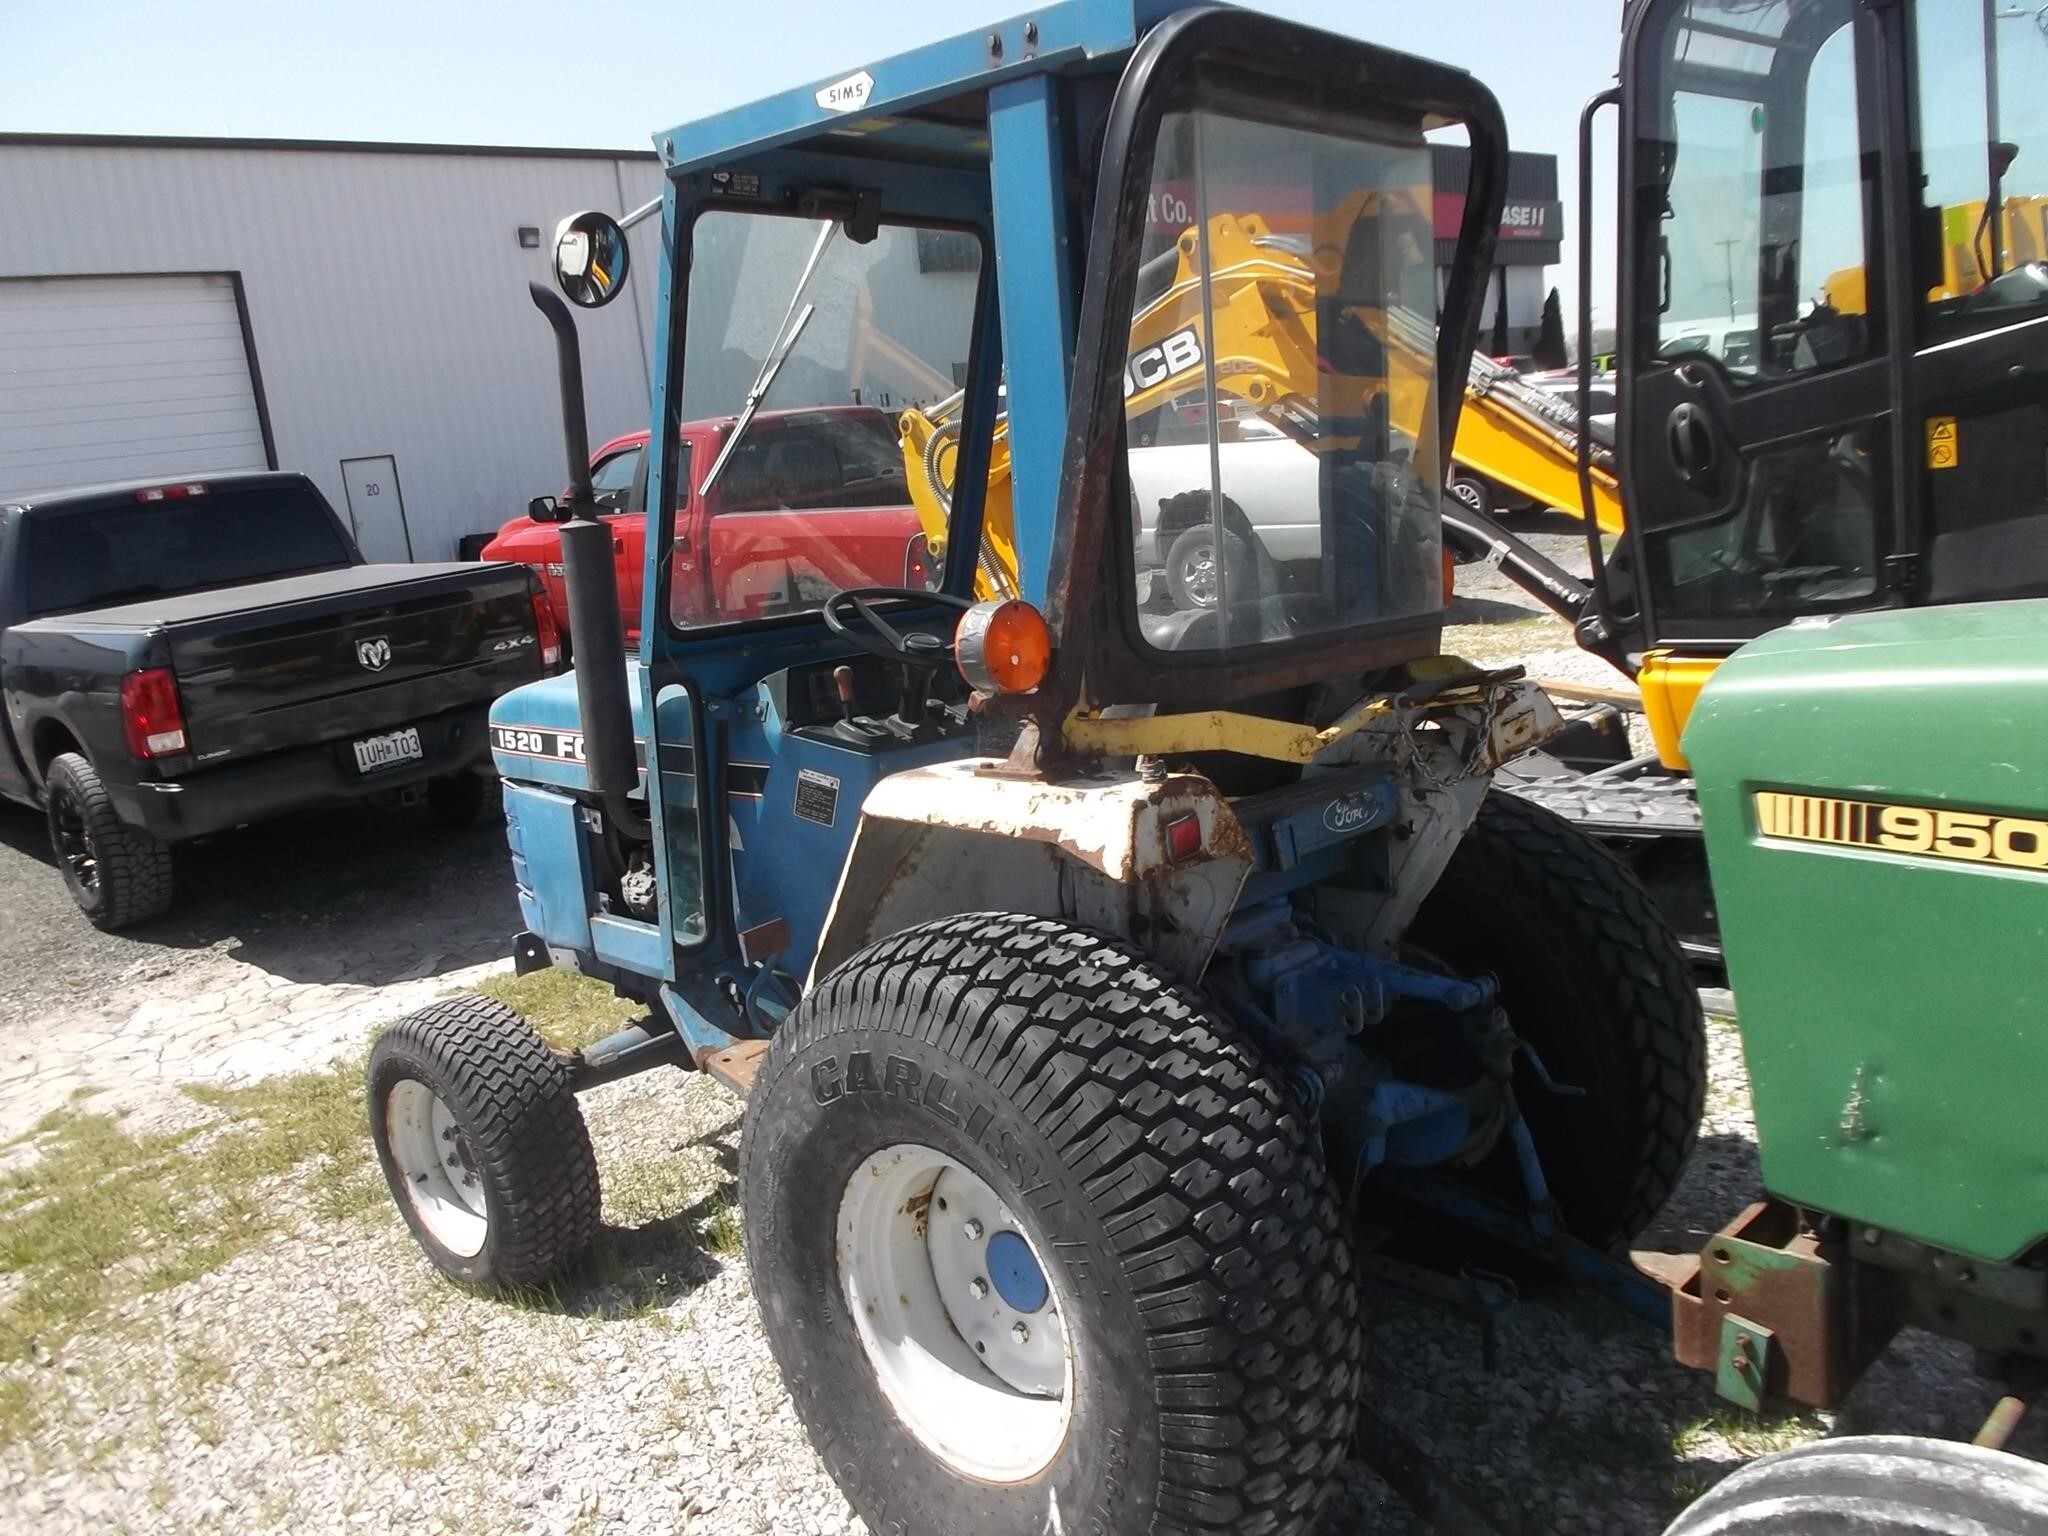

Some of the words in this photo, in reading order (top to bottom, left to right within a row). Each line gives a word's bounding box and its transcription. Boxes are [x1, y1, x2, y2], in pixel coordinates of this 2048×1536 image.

[829, 83, 864, 103] SIMS
[1161, 193, 1193, 223] Co.
[366, 483, 380, 497] 20
[498, 730, 543, 753] 1520
[1878, 805, 2048, 868] 950
[810, 1050, 1103, 1297] CARLISLE
